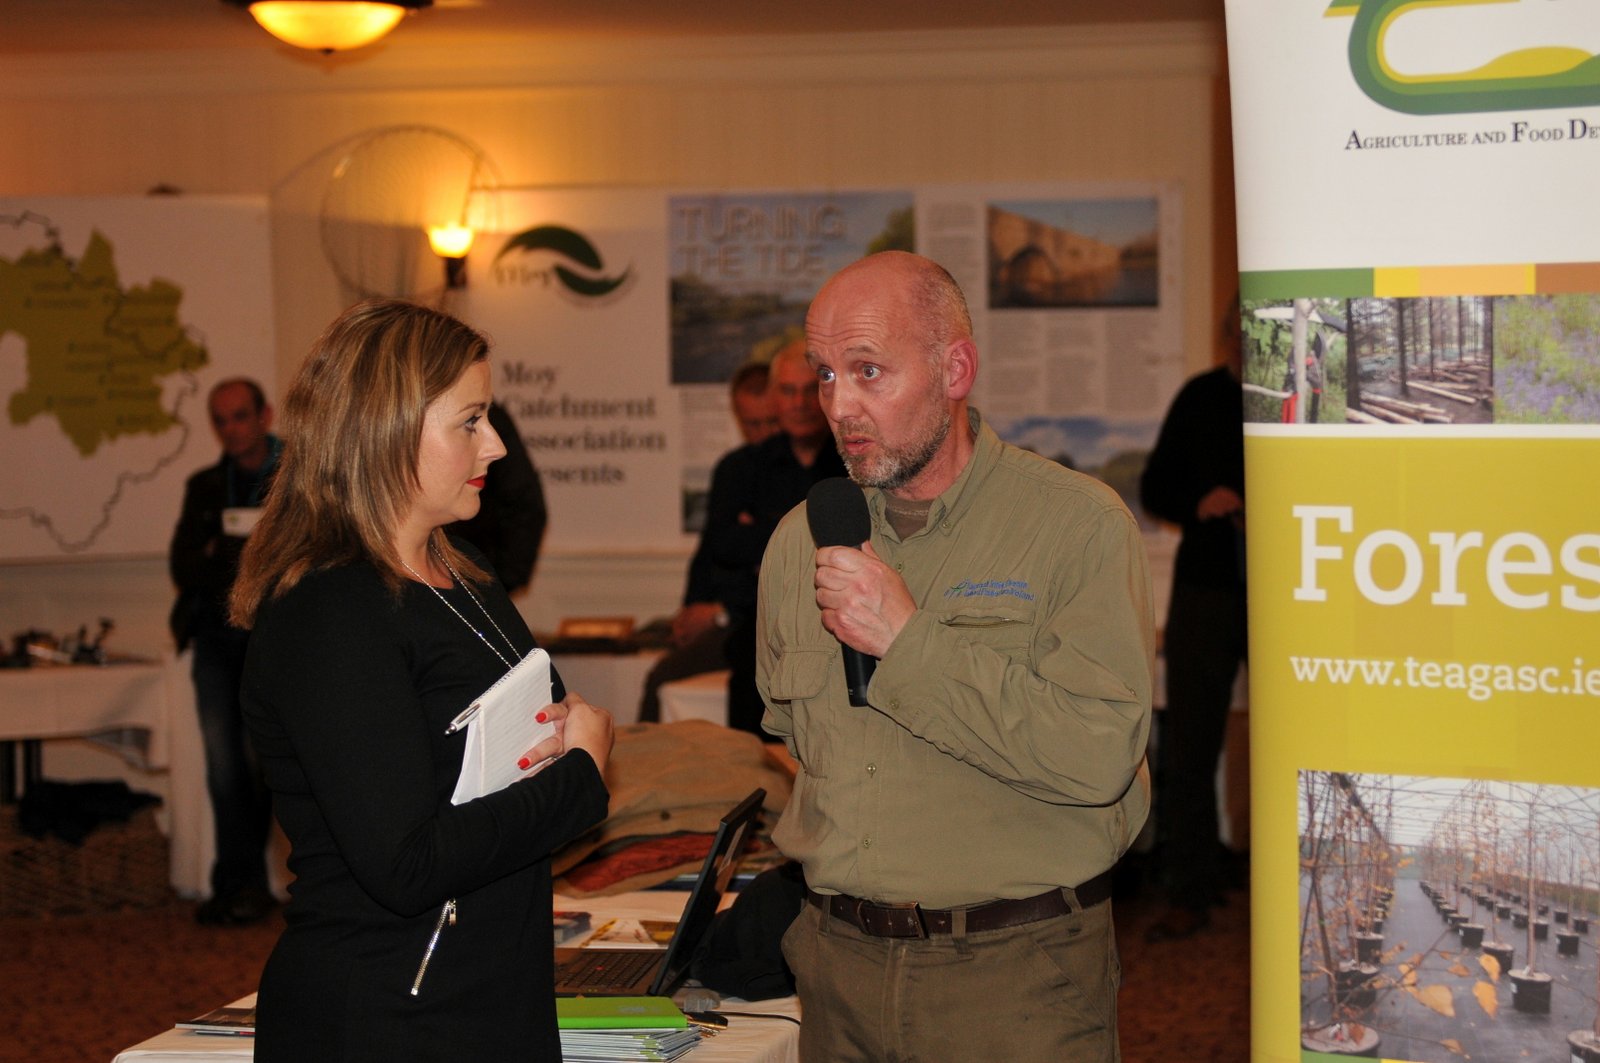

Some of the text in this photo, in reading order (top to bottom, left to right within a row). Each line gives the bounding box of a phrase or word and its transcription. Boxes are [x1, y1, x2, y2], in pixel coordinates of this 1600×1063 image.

[1344, 118, 1600, 151] AGRICULTURE AND FOOD DE
[502, 361, 556, 392] Moy
[1292, 504, 1600, 612] Fores
[1290, 656, 1600, 701] www.teagasc.ie
